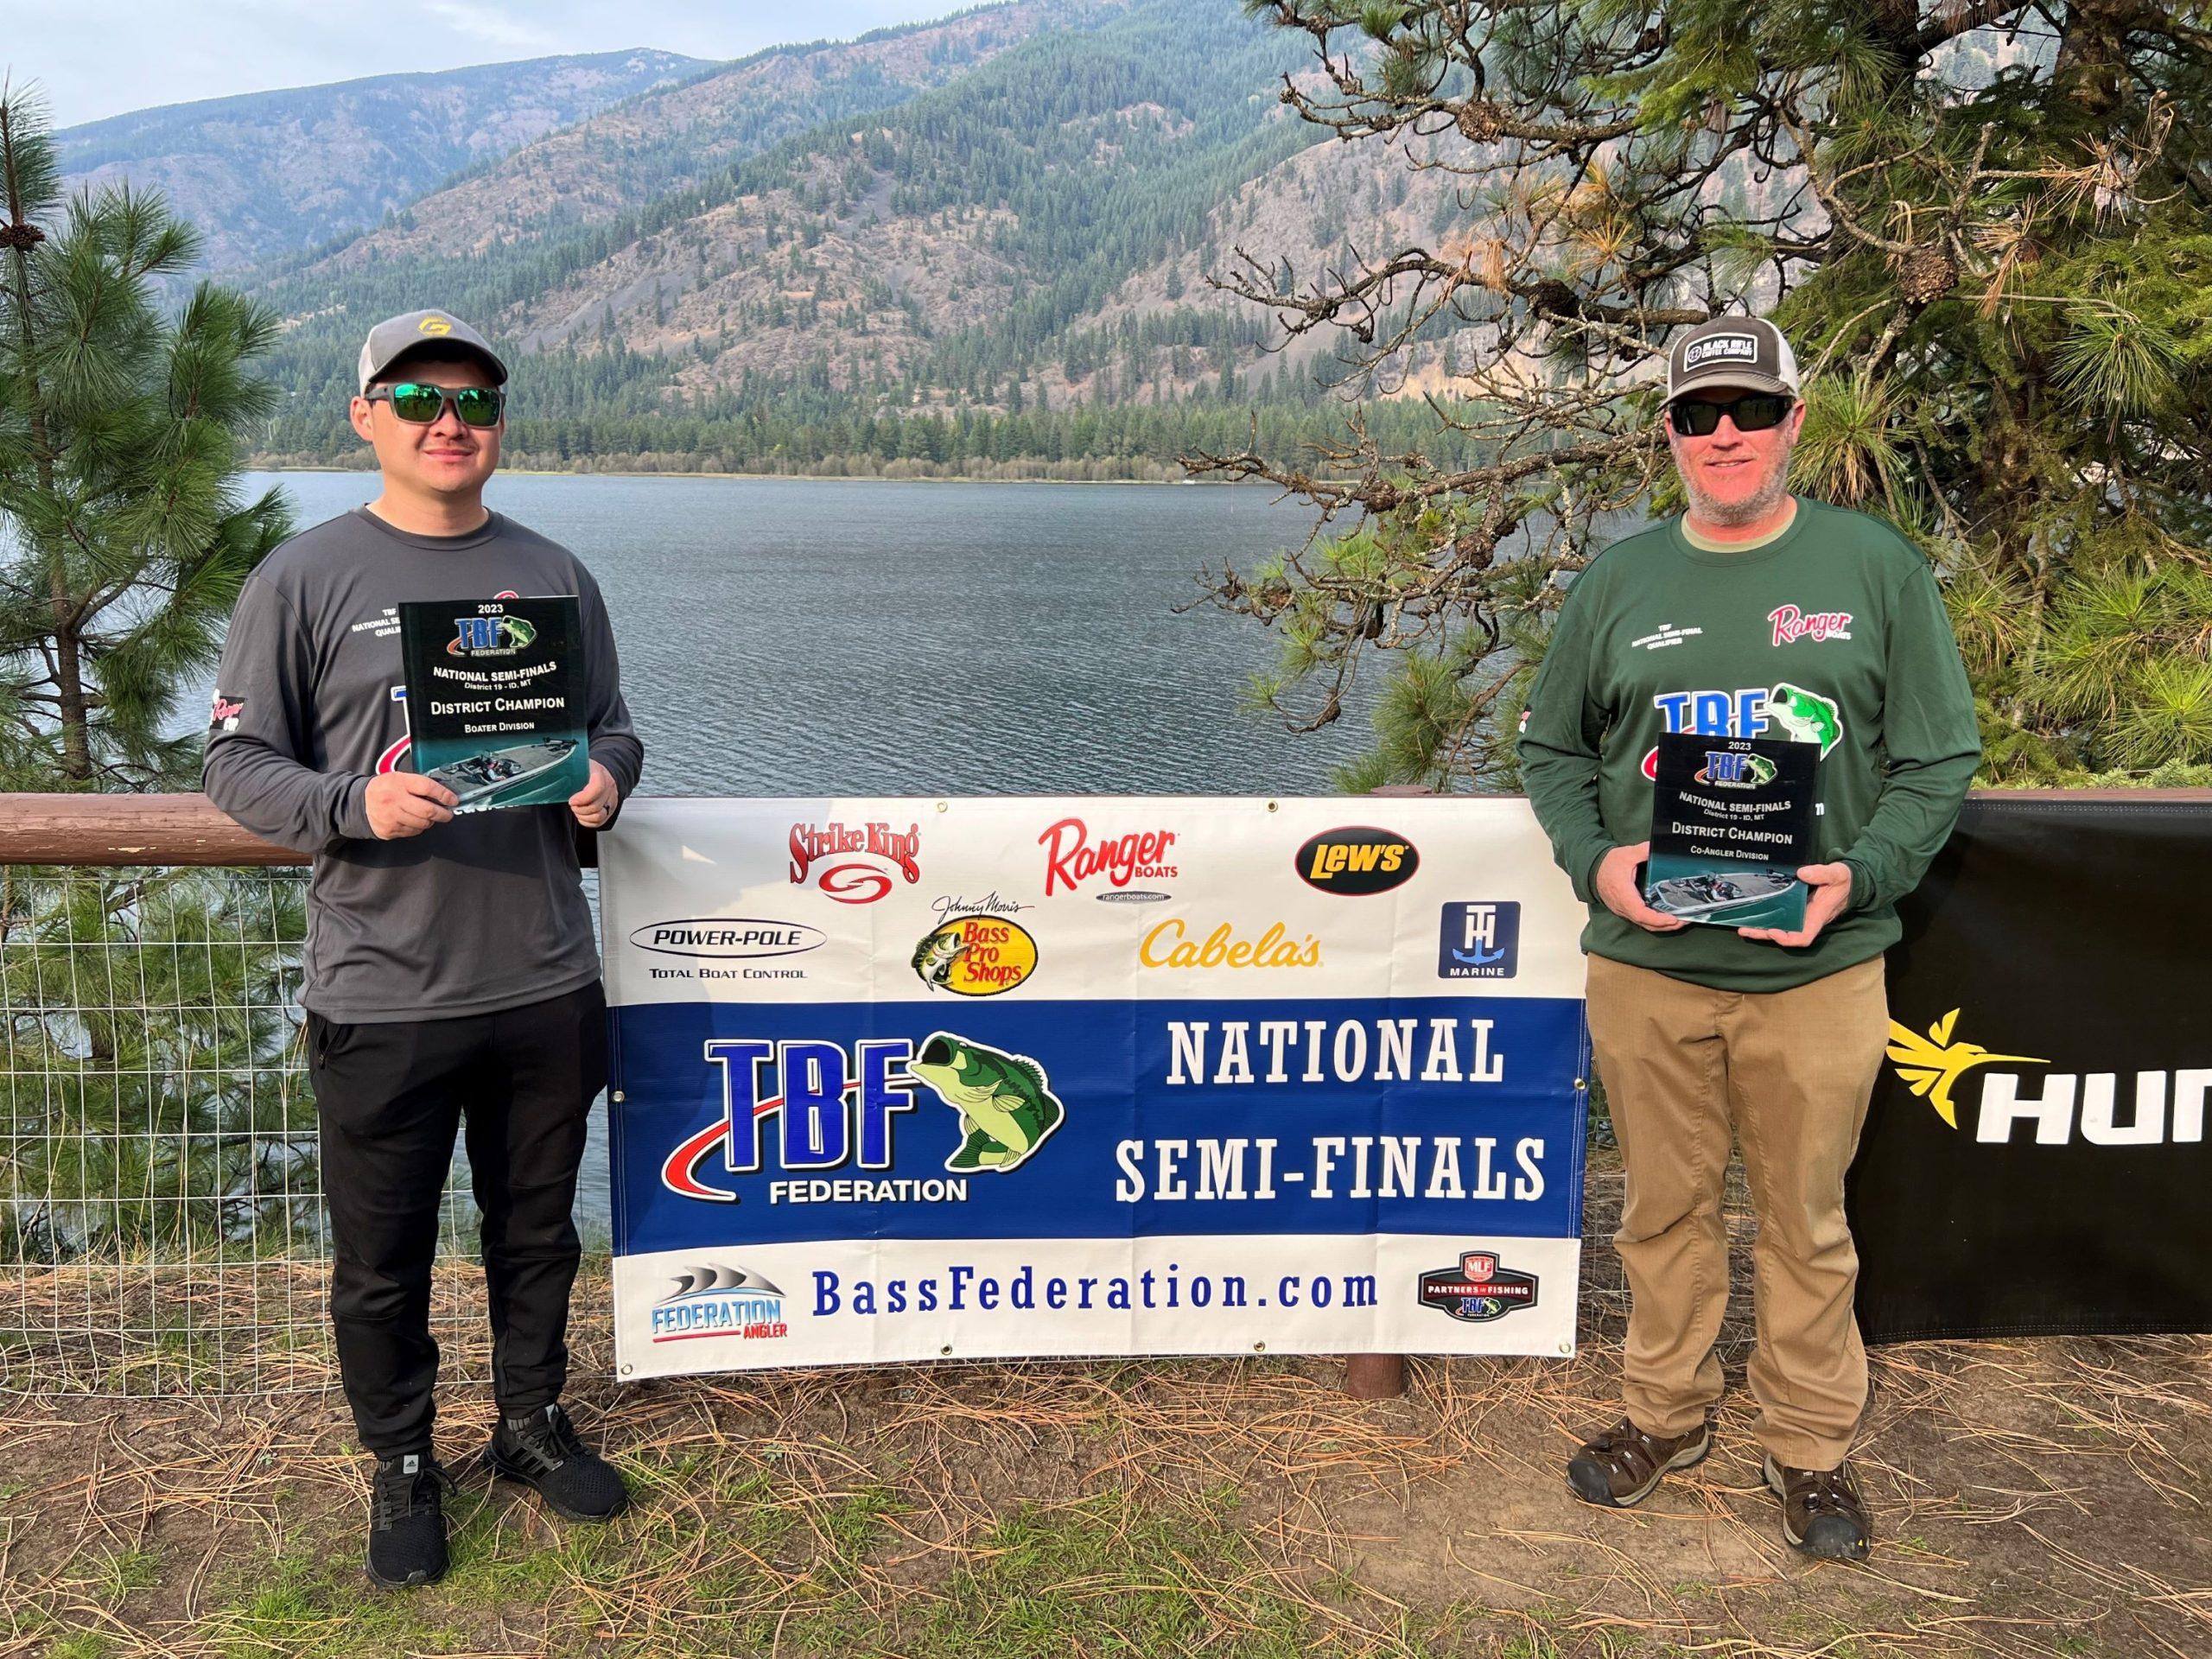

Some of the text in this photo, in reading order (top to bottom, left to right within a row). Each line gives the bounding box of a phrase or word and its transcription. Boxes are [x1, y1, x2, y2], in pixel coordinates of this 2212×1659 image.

[478, 604, 504, 613] 2023
[352, 619, 391, 632] NATIONAL
[454, 617, 503, 649] TBF
[1767, 604, 1853, 646] Ranger
[433, 661, 557, 682] NATIONAL SEMI-FINALS
[464, 682, 492, 690] District
[520, 678, 531, 688] MT
[1728, 741, 1751, 750] 2023
[1706, 751, 1748, 781] TBF
[1714, 780, 1756, 789] FEDERATION
[1680, 791, 1791, 812] NATIONAL SEMI-FINALS
[1704, 808, 1728, 819] District
[790, 823, 920, 884] Strike King
[1038, 818, 1176, 897] Ranger
[1135, 866, 1178, 878] BOATS
[931, 891, 1035, 925] Johnny Morris
[653, 930, 802, 945] POWER-POLE
[962, 921, 1009, 944] Bass
[1140, 918, 1320, 969] Cabela's
[963, 942, 1000, 963] Pro
[963, 962, 1021, 987] Shops
[1449, 967, 1505, 976] MARINE
[1166, 1018, 1504, 1085] NATIONAL
[704, 1039, 914, 1173] TBF
[1115, 1137, 1545, 1203] SEMI-FINALS
[770, 1179, 967, 1205] FEDERATION
[1468, 1261, 1491, 1273] MLF
[812, 1263, 1378, 1317] BassFederation.com
[1487, 1286, 1529, 1294] FISHING
[652, 1299, 781, 1334] FEDERATION
[743, 1322, 788, 1339] ANGLER
